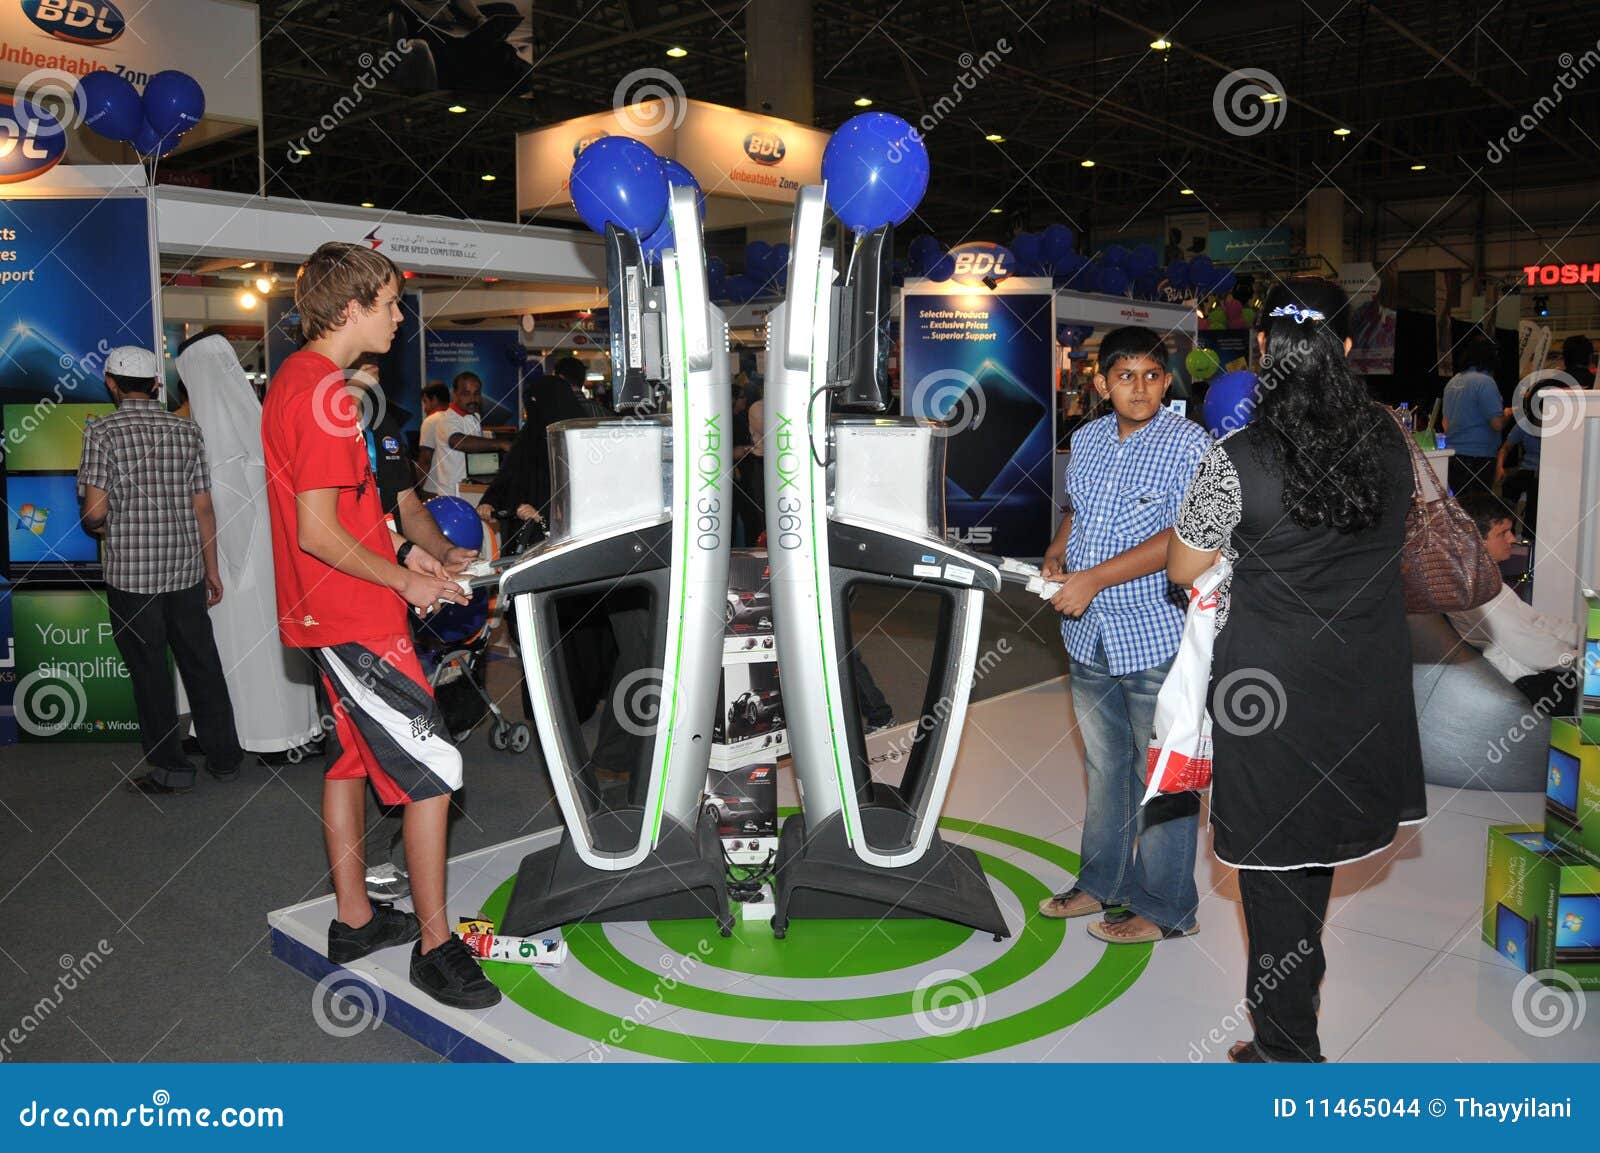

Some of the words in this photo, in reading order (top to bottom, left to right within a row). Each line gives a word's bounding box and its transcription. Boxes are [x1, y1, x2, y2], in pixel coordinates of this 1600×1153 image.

[36, 0, 113, 33] BDL
[115, 64, 151, 86] Zon
[749, 136, 782, 158] BDL
[730, 169, 777, 188] Unbeatable
[779, 177, 799, 190] Zone
[390, 243, 409, 253] SUPER
[410, 246, 429, 255] SPEED
[430, 248, 463, 258] COMPUTERS
[954, 252, 1007, 275] BDL
[1523, 262, 1600, 287] TOSH
[919, 310, 953, 319] Selective
[954, 310, 989, 319] Products
[929, 321, 964, 329] Exclusive
[965, 321, 988, 330] Prices
[931, 331, 964, 341] Superior
[965, 331, 996, 341] Support
[699, 412, 721, 492] XBOX
[776, 412, 800, 492] XBOX
[697, 497, 721, 551] 360
[778, 497, 802, 551] 360
[35, 623, 90, 645] Your
[99, 623, 114, 644] P
[38, 656, 131, 682] simplifie
